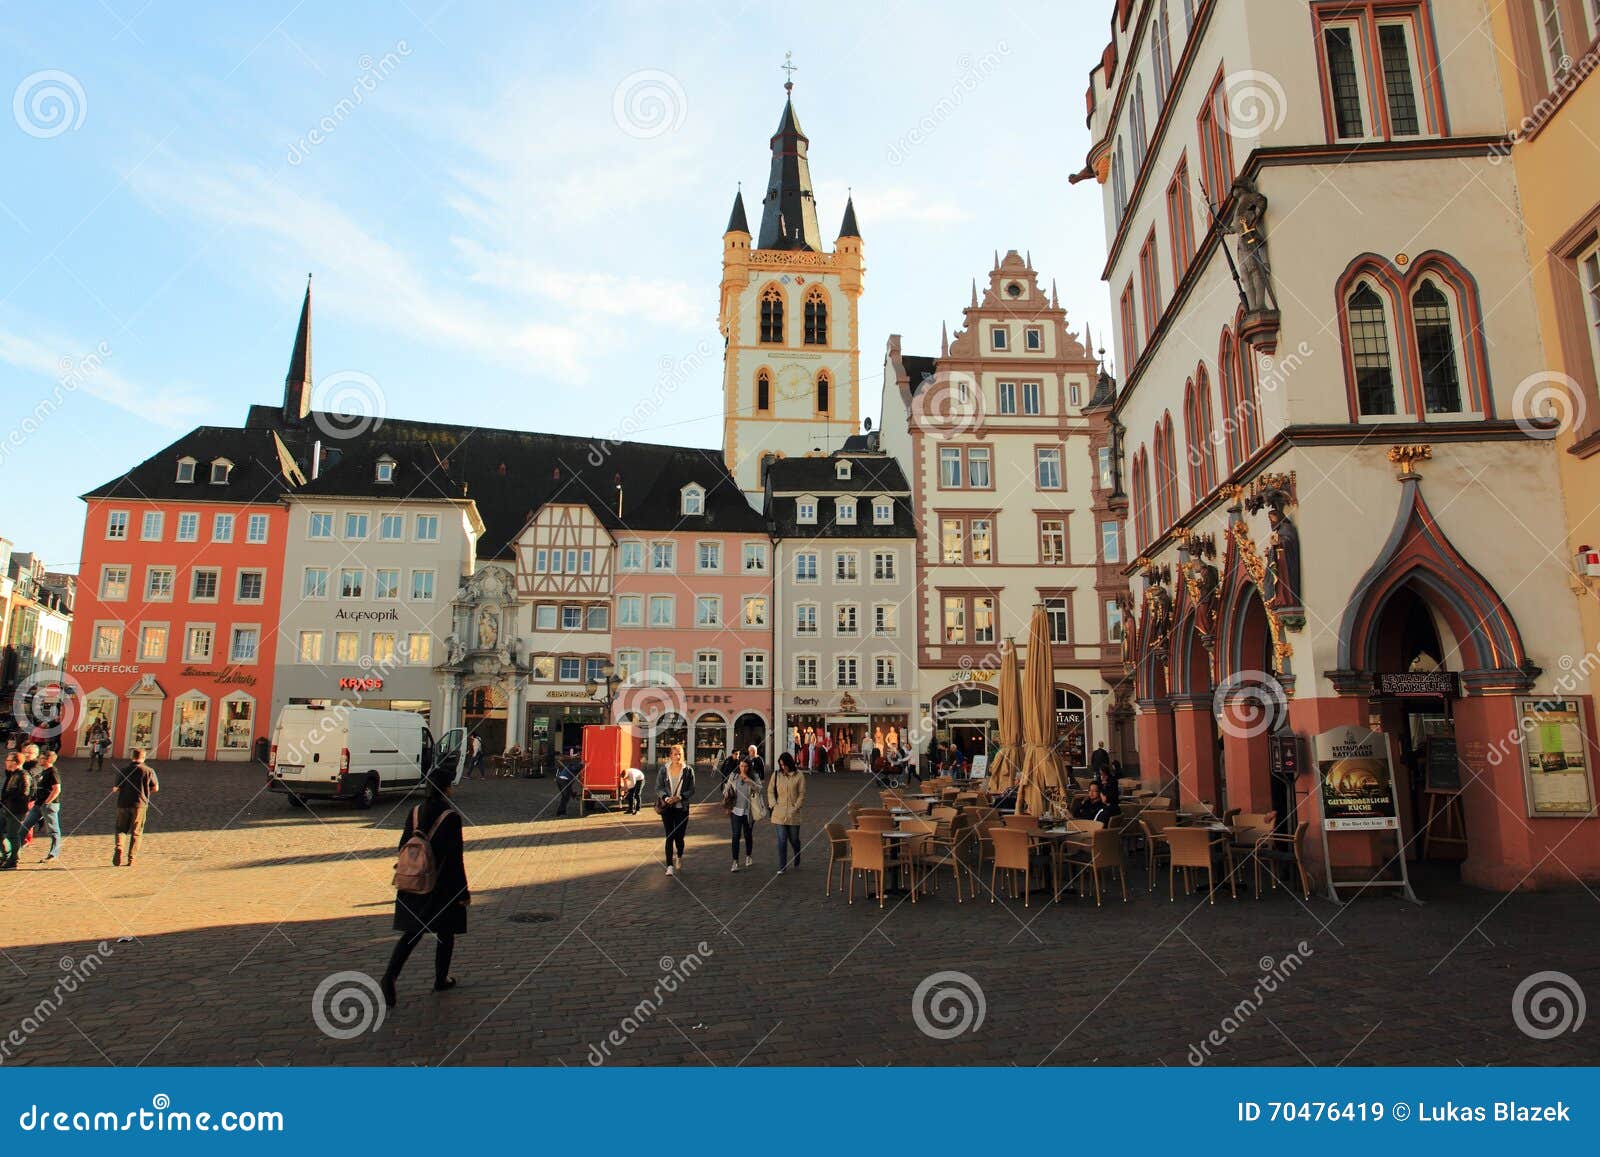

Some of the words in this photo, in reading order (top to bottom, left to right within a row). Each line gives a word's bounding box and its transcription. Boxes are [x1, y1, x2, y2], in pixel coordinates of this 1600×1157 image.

[72, 664, 112, 673] KOFFER
[112, 665, 140, 673] ECKE
[950, 671, 996, 681] SUBWAY
[339, 678, 384, 690] KRASS
